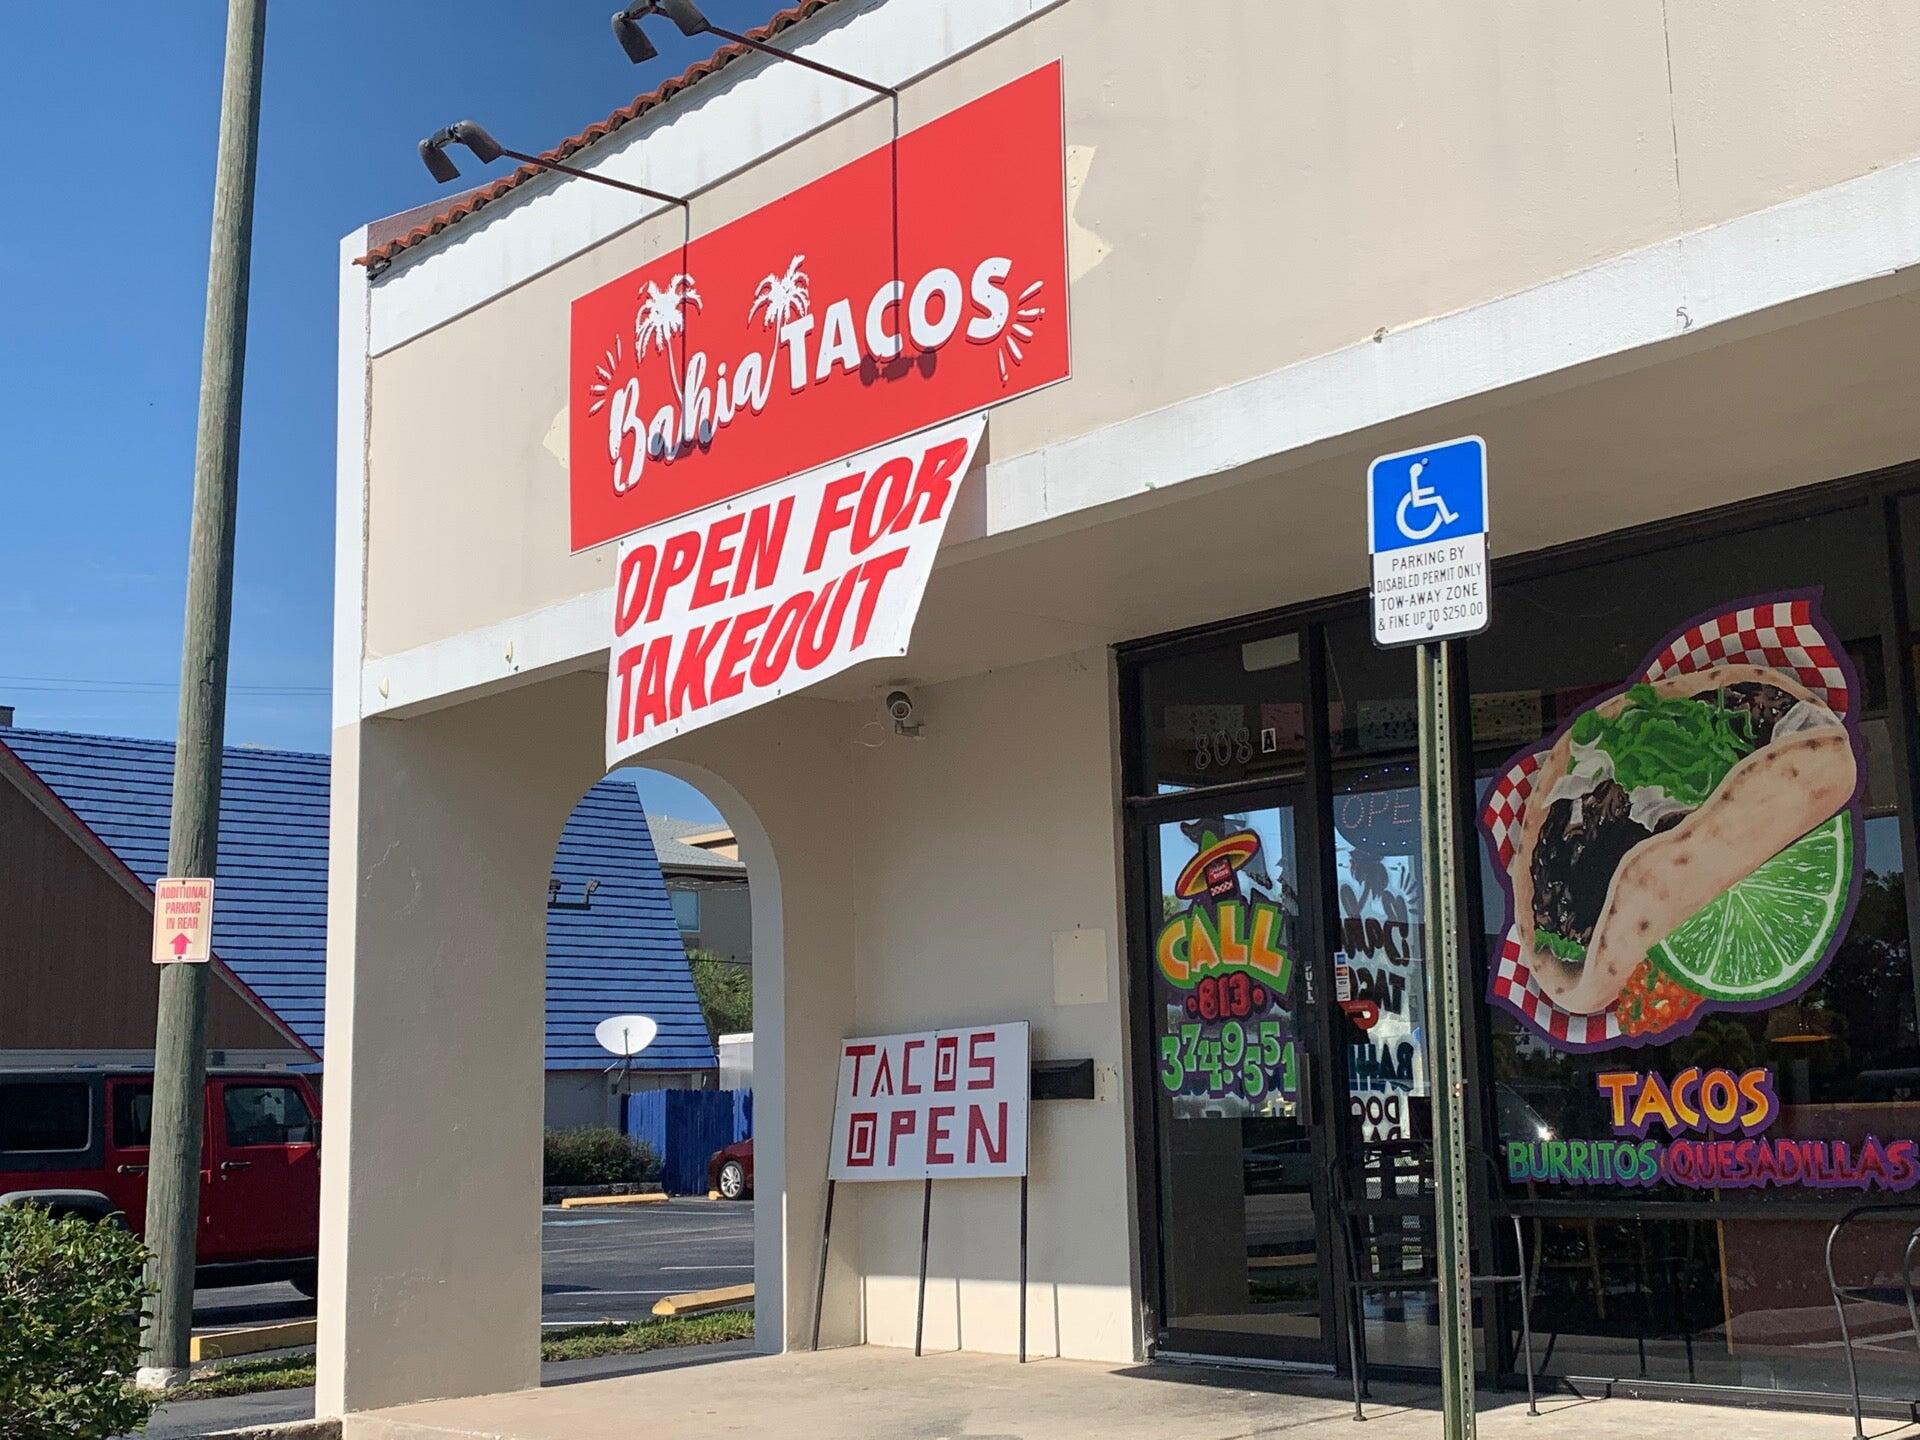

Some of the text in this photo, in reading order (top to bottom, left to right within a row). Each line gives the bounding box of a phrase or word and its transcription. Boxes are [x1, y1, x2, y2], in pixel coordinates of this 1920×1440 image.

[608, 257, 1013, 494] Bahia TACOS
[615, 437, 968, 637] OPEN FOR
[1392, 545, 1465, 571] PARKING BY
[1377, 562, 1482, 594] DISABLED PERMIT ONLY
[1380, 582, 1479, 611] TOW-AWAY ZONE
[1378, 601, 1483, 631] & FINE UP TO $250.00
[616, 546, 910, 744] TAKEOUT
[1195, 727, 1276, 770] 808 A
[1342, 789, 1421, 829] OPE
[160, 886, 208, 899] ADDITIONAL
[165, 902, 201, 914] PARKING
[166, 917, 198, 929] IN REAR
[1157, 903, 1288, 987] CALL
[845, 1032, 995, 1097] TACOS
[1598, 1067, 1771, 1129] TACOS
[846, 1102, 1008, 1167] OPEN
[1508, 1137, 1915, 1182] BURRITOS QUESADILLAS
